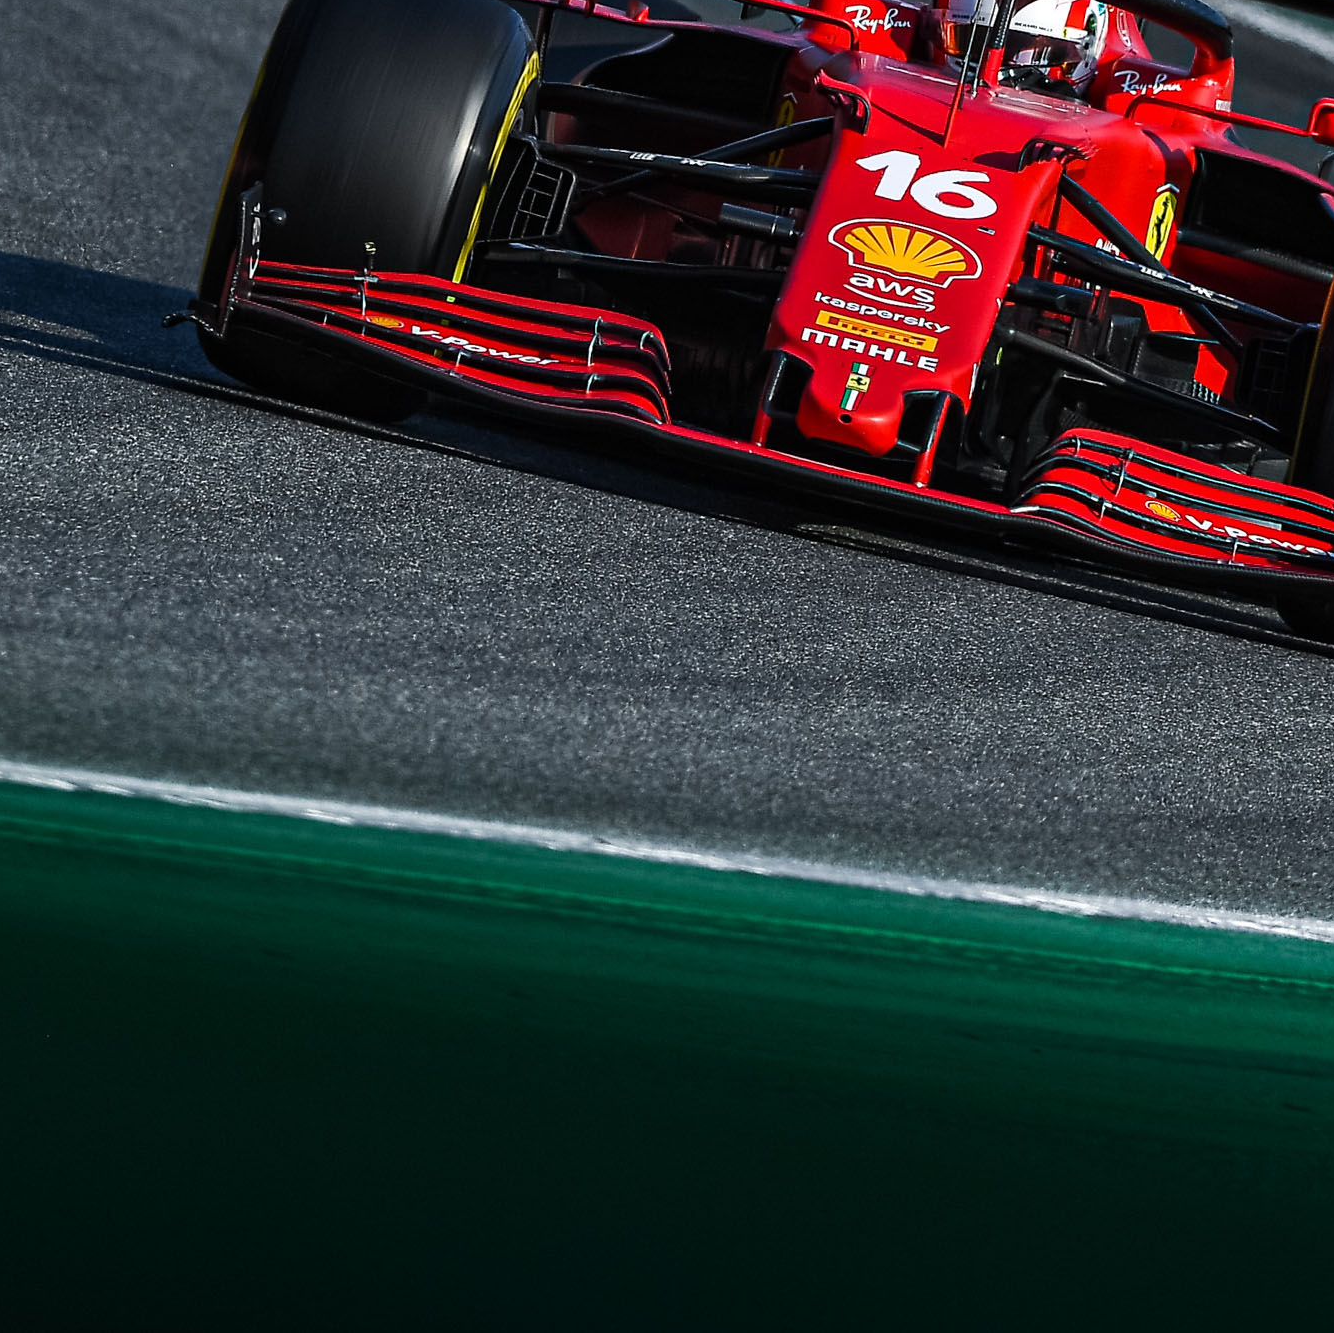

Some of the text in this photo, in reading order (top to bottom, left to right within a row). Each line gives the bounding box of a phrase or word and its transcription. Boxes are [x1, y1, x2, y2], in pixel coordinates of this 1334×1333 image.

[845, 5, 911, 34] Ray-Ban
[1114, 70, 1182, 95] Ray-Ban
[855, 150, 998, 220] 16
[849, 272, 935, 303] aws
[814, 291, 951, 333] kaspersky
[411, 325, 560, 365] V-Power
[801, 327, 939, 373] MAHLE
